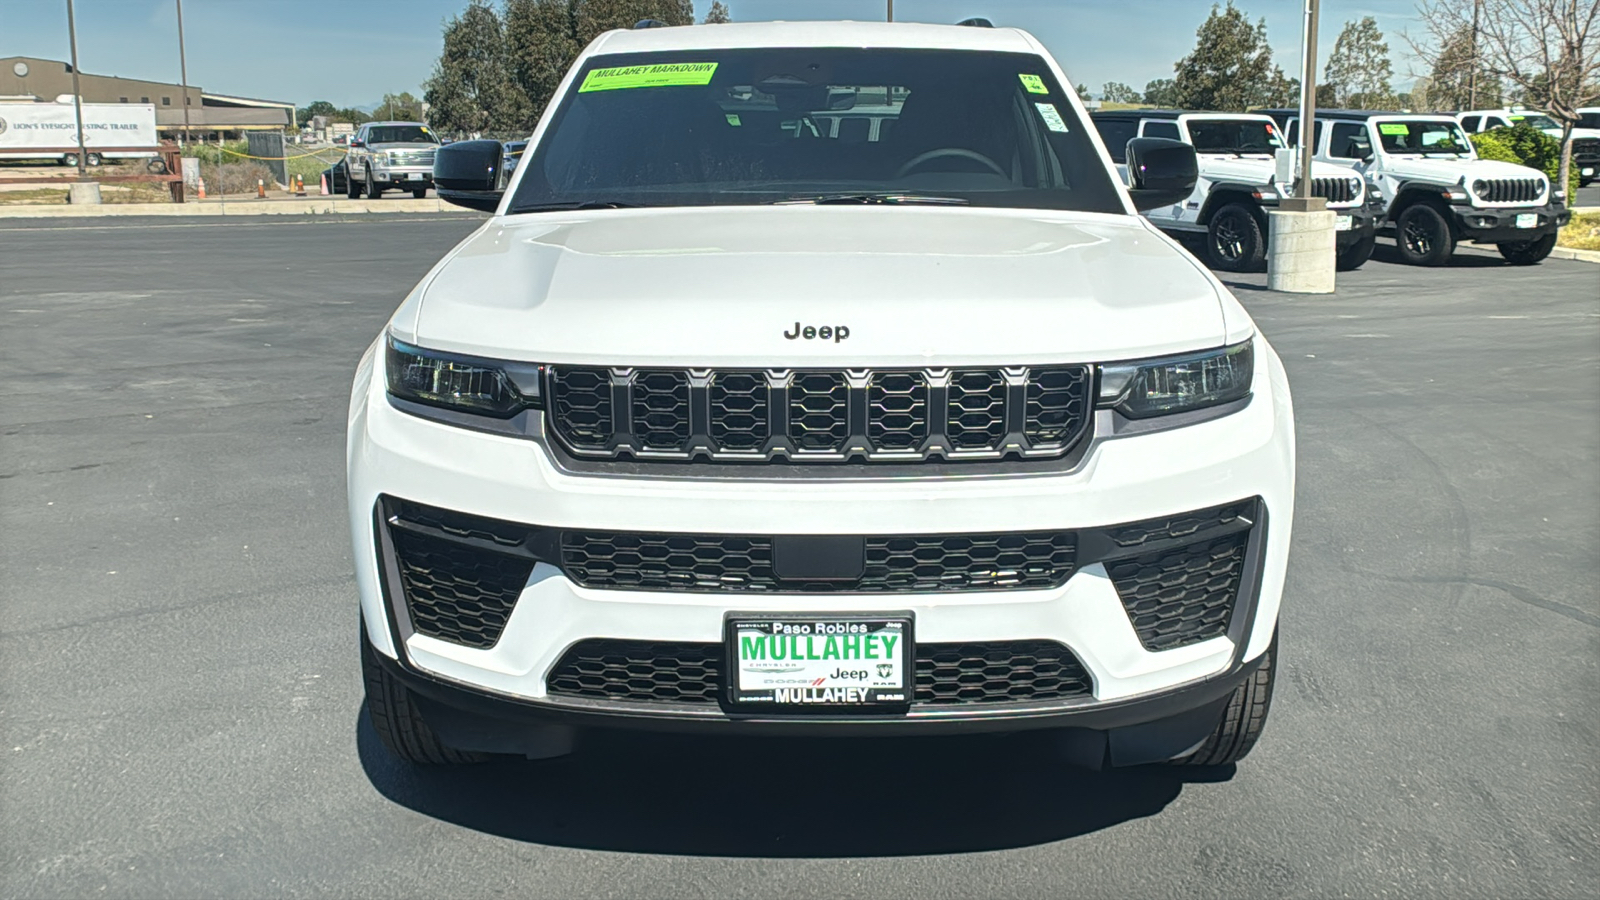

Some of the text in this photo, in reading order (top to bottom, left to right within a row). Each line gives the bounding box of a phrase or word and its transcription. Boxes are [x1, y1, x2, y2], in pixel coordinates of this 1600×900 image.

[594, 64, 714, 79] MULLAHEY MARKDOWN
[783, 321, 850, 344] Jeep
[772, 622, 868, 634] Paso Robles
[741, 635, 899, 661] MULLAHEY
[830, 667, 869, 682] Jeep
[775, 687, 869, 703] MULLAHEY
